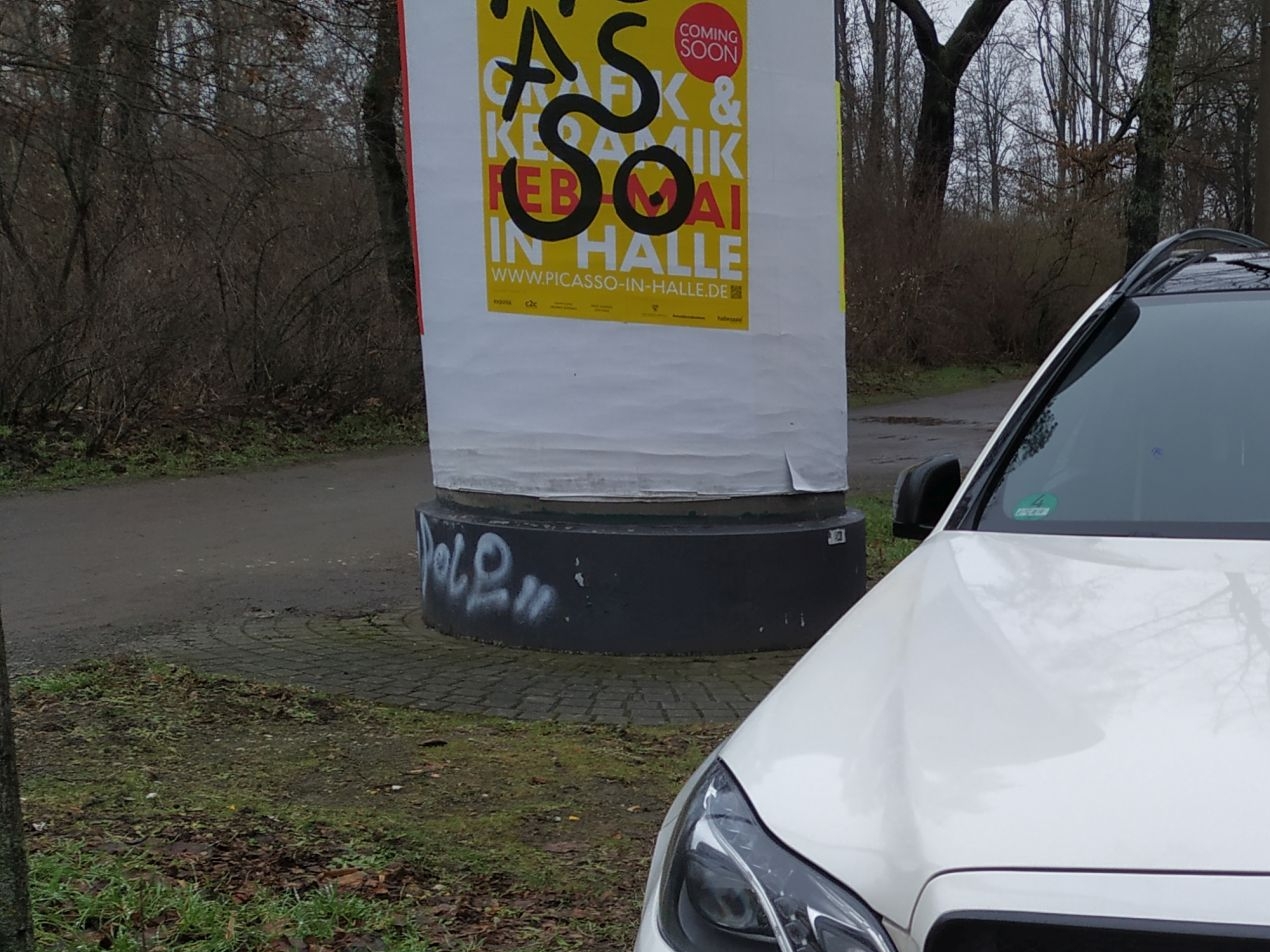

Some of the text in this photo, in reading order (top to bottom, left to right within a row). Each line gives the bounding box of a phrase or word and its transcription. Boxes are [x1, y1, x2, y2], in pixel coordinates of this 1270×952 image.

[679, 23, 738, 43] COMING
[680, 39, 738, 64] SOON
[709, 75, 742, 127] &
[490, 216, 743, 281] IN HALLE
[491, 267, 728, 299] WWW.PICASSO-IN-HALLE.DE
